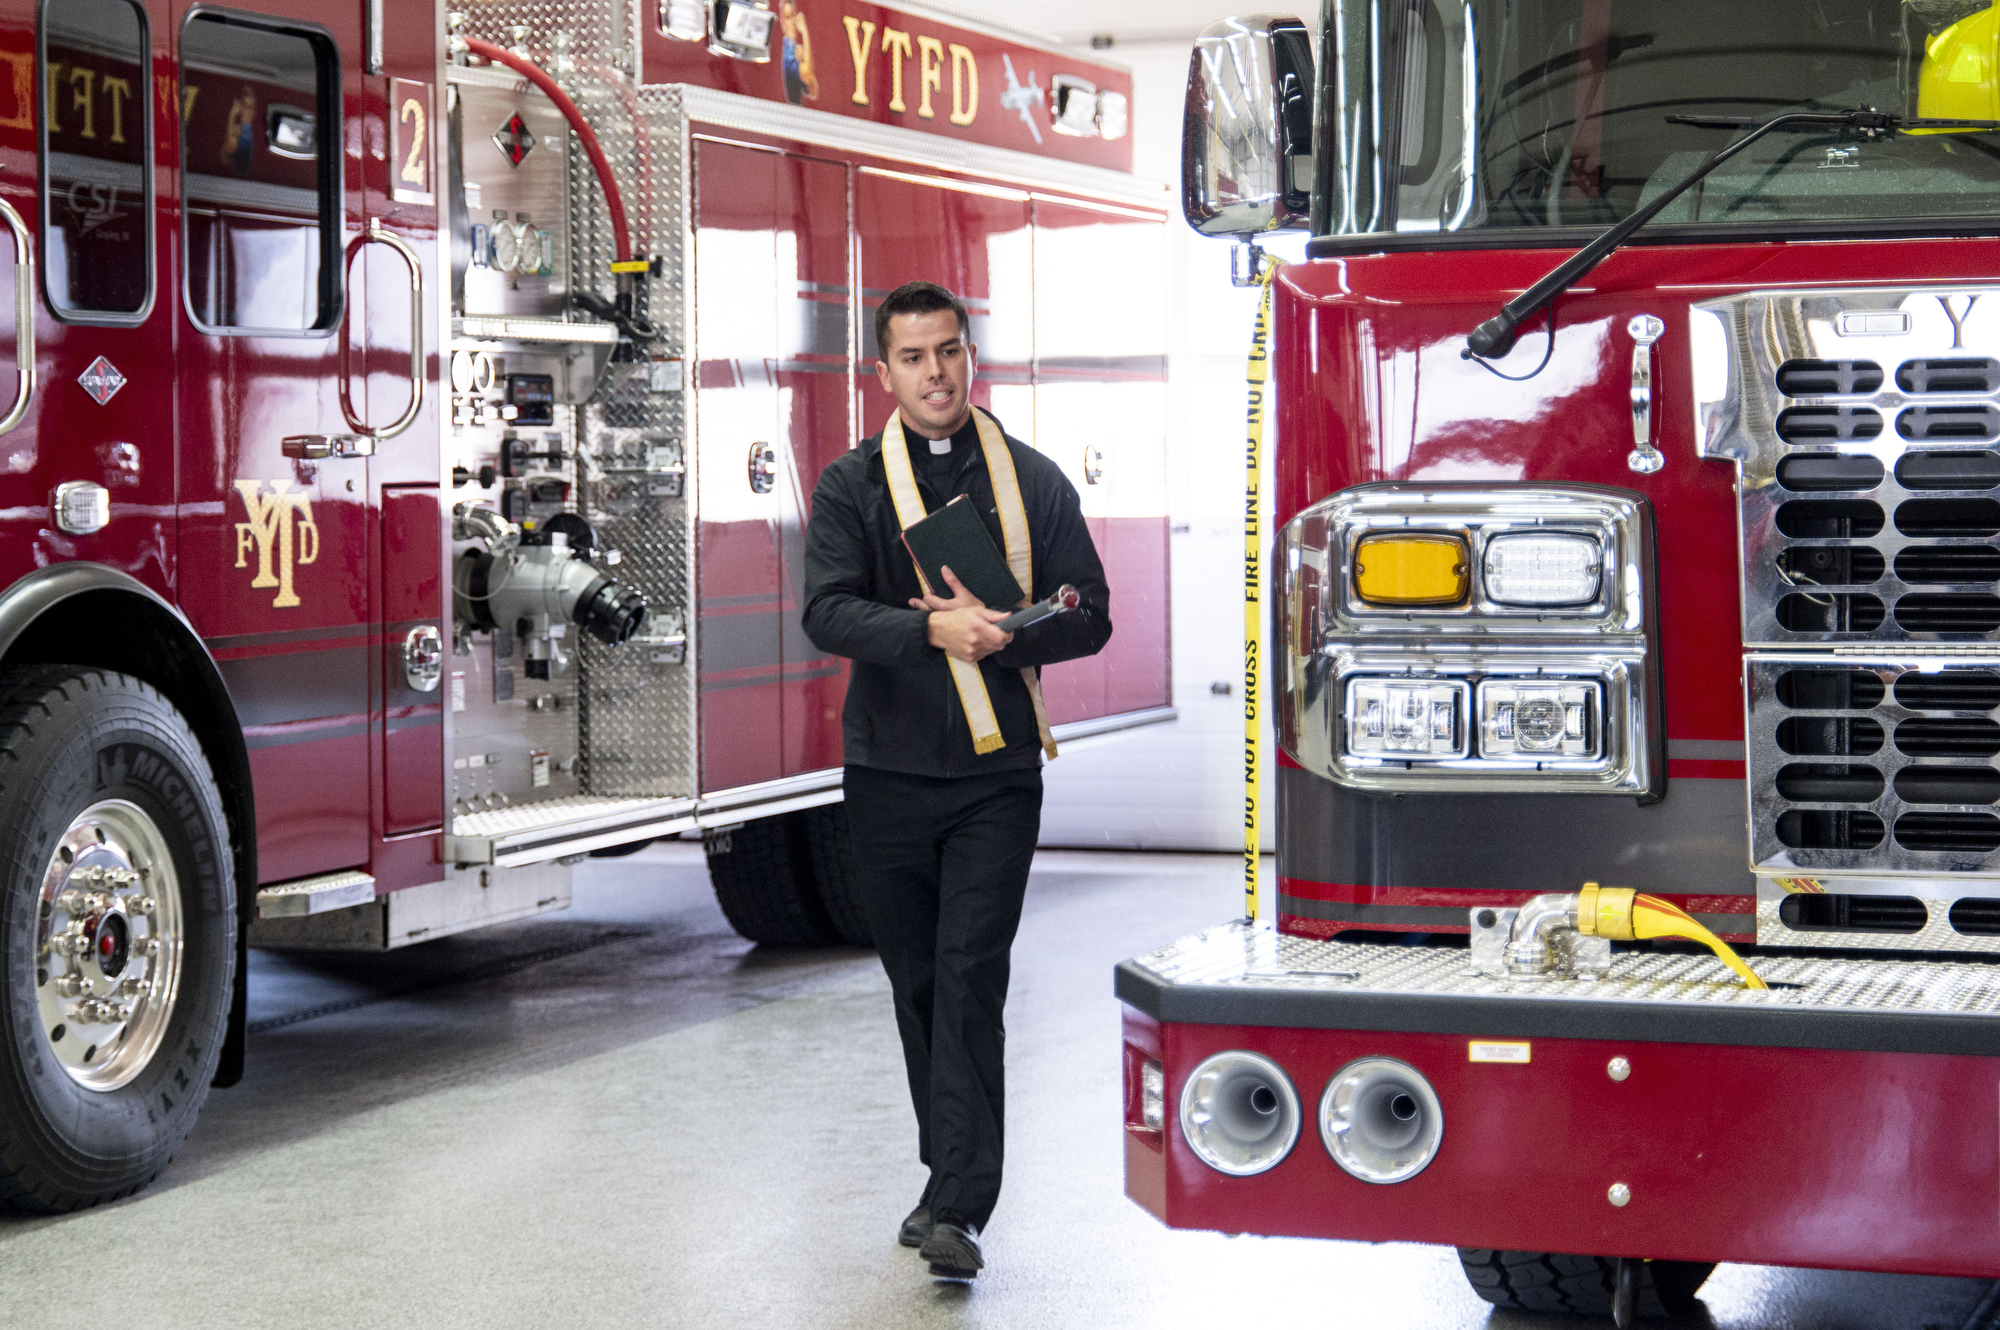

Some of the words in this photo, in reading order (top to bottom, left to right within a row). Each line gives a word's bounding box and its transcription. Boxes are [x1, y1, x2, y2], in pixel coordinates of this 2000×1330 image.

[843, 15, 979, 126] YTFD
[401, 98, 425, 186] 2
[1935, 294, 1983, 350] Y
[1246, 379, 1264, 424] NOT
[1246, 438, 1258, 470] DO
[1246, 483, 1258, 536] LINE
[1245, 550, 1258, 602] FIRE
[1244, 639, 1257, 721] CROSS
[1244, 732, 1255, 784] NOT
[131, 753, 219, 913] MICHELIN
[1244, 796, 1255, 829] DO
[1244, 842, 1255, 896] LINE
